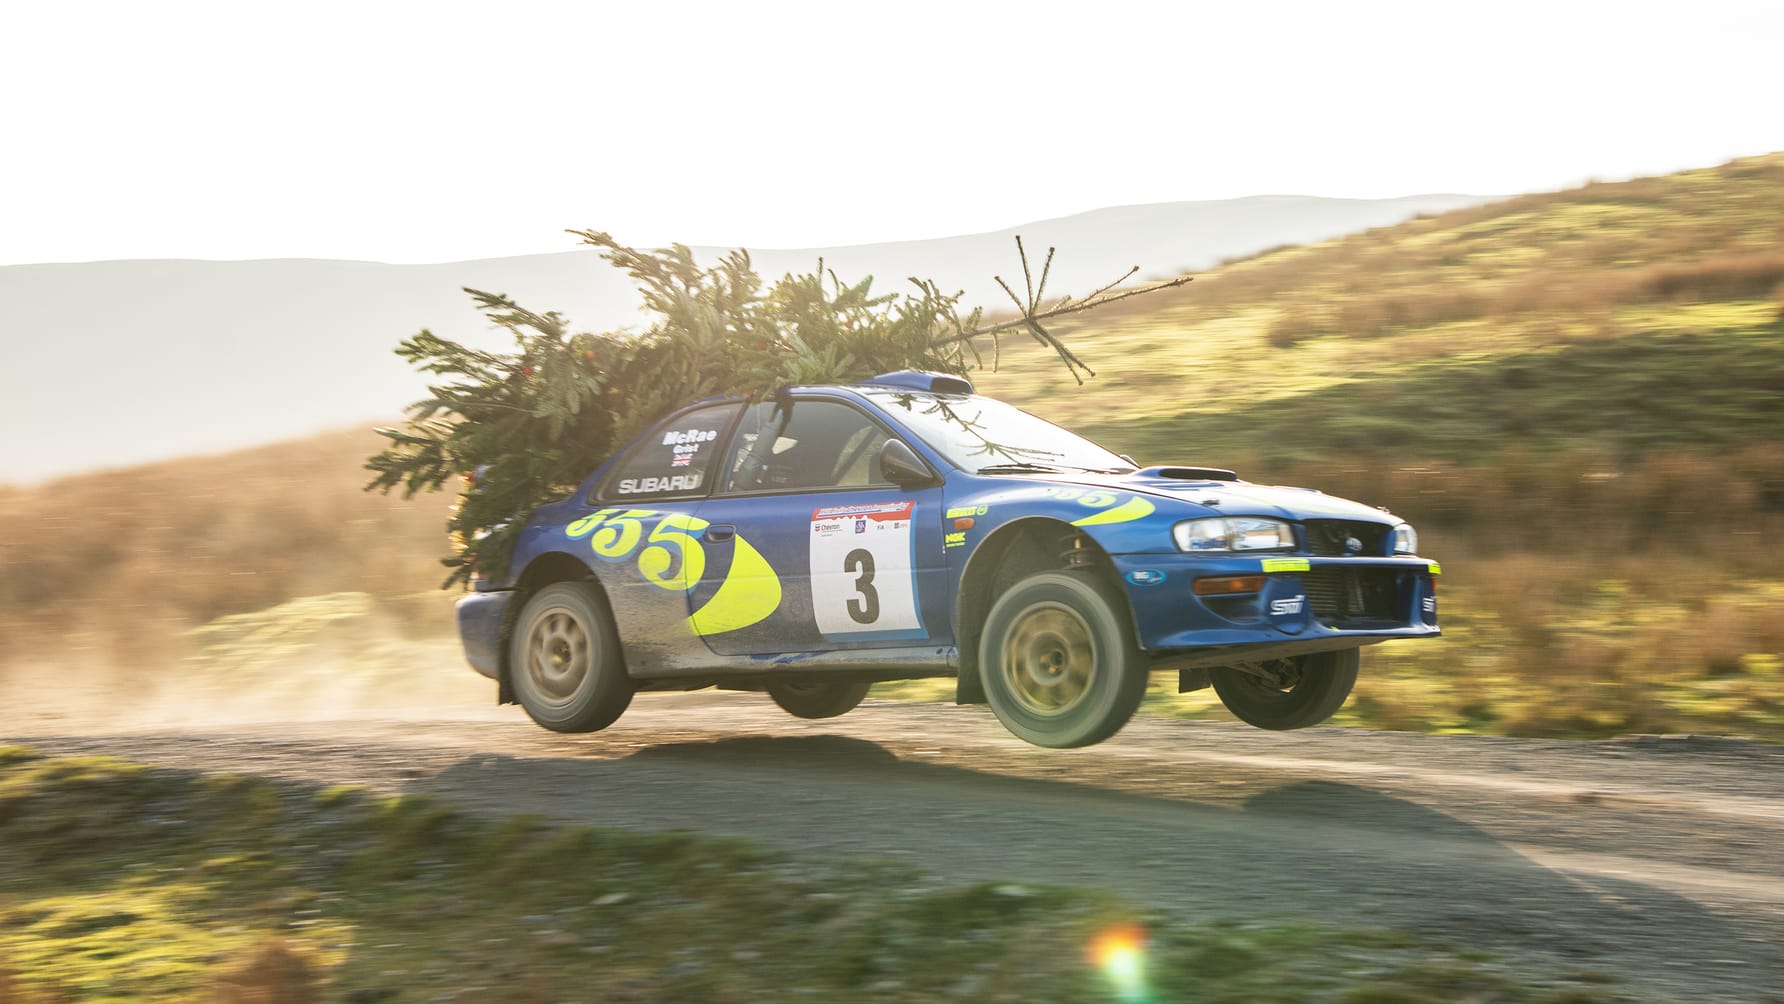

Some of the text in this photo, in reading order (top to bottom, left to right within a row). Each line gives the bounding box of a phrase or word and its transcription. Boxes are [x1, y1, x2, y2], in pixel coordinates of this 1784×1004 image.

[662, 429, 717, 445] McRae
[618, 474, 699, 494] SUBARU
[1041, 487, 1120, 508] 55
[565, 508, 711, 592] 555
[844, 548, 880, 624] 3
